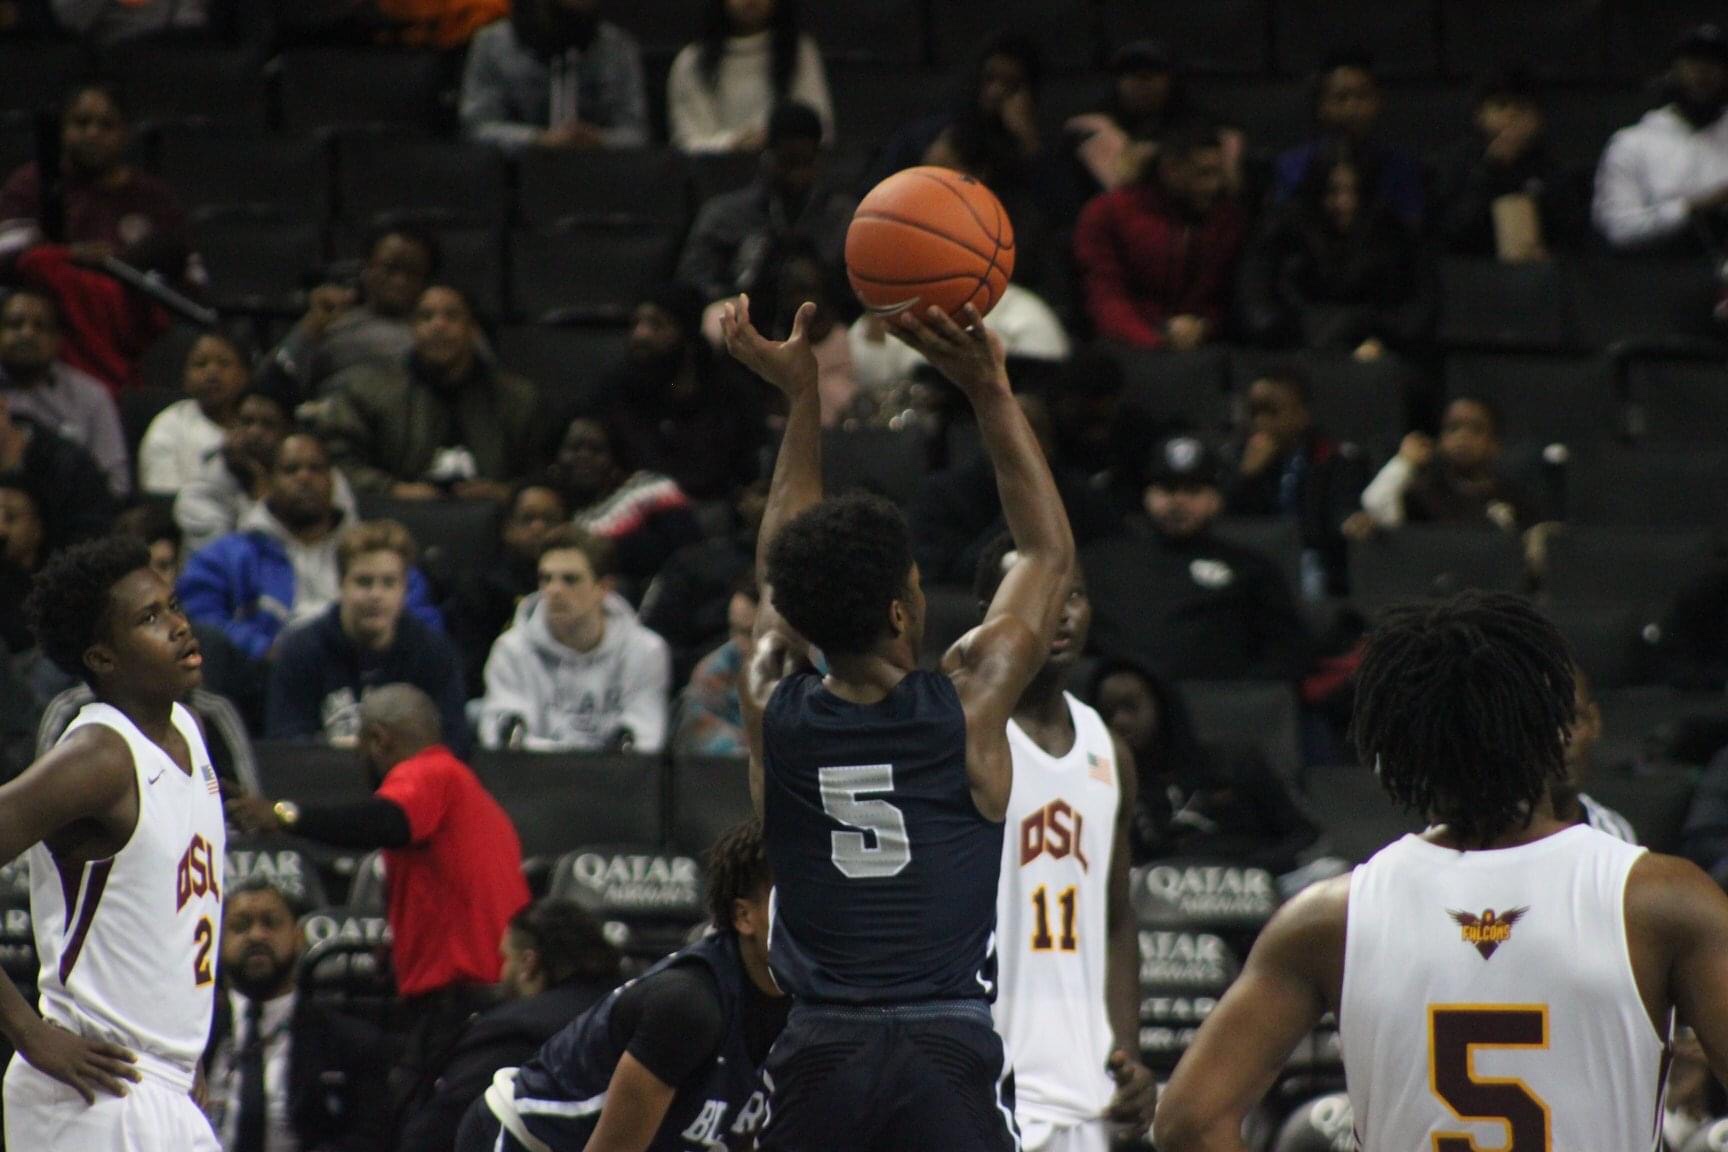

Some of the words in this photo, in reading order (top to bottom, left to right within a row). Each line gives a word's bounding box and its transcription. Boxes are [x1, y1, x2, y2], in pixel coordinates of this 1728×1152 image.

[818, 764, 911, 878] 5
[573, 852, 698, 892] QATAR
[1146, 865, 1272, 903] QATAR
[193, 914, 216, 988] 2
[1030, 883, 1080, 952] 11
[1461, 924, 1511, 943] FALCONS
[1427, 1004, 1552, 1152] 5
